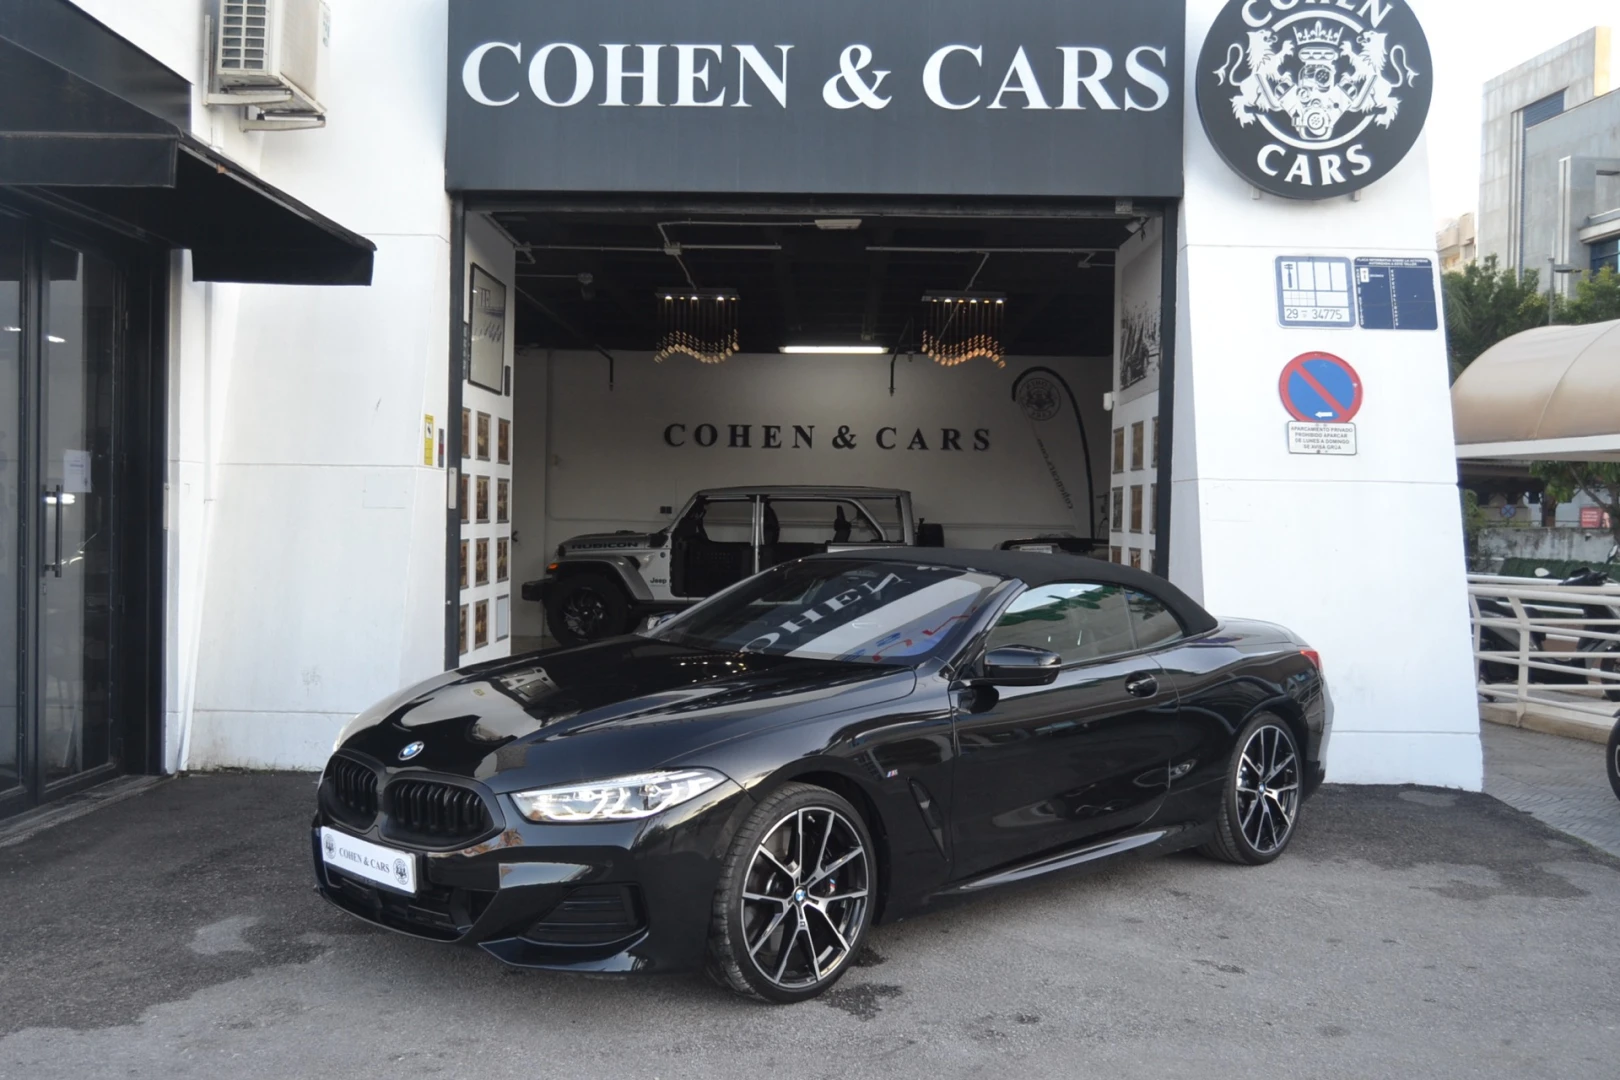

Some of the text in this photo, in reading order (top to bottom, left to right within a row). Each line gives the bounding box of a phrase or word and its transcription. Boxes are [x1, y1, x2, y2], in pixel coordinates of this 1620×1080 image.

[461, 41, 1170, 112] COHEN & CARS
[1256, 144, 1372, 186] CARS
[1286, 308, 1298, 319] 29
[1312, 308, 1343, 320] 34775
[663, 423, 992, 452] COHEN & CARS
[650, 577, 667, 585] Jeep
[339, 847, 362, 863] COHEN
[363, 856, 369, 867] &
[370, 858, 390, 874] CARS
